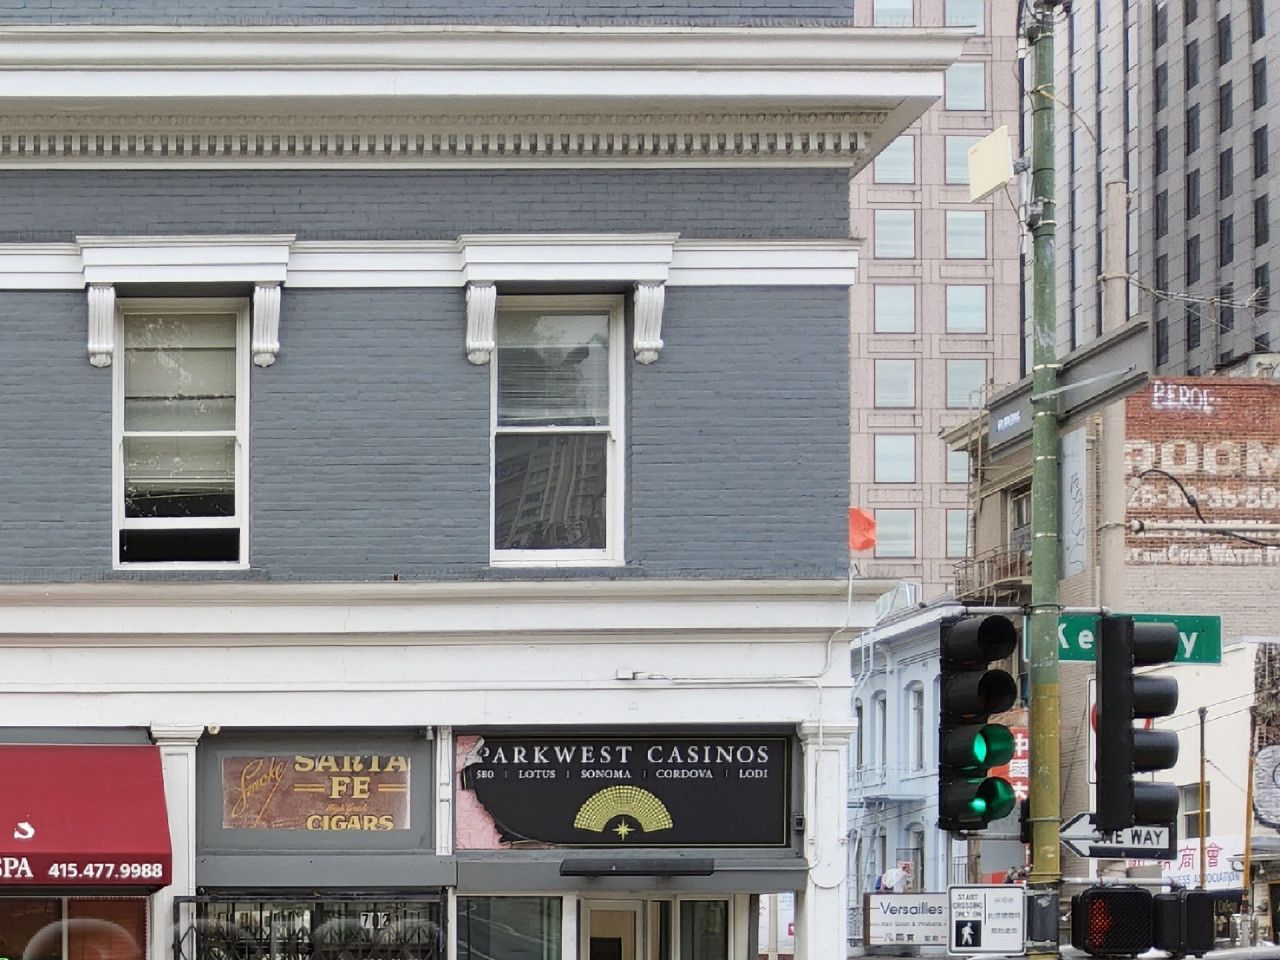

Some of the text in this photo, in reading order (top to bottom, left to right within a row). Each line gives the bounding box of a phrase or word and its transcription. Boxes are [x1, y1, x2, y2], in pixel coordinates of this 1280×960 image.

[647, 745, 769, 763] CASINOS
[519, 769, 556, 779] LOTUS
[581, 769, 632, 779] SONOMA
[656, 769, 713, 779] CORDOVA
[739, 769, 768, 779] LODI
[329, 775, 371, 799] FE
[306, 815, 394, 831] CIGARS
[1131, 828, 1163, 845] WAY
[48, 863, 163, 878] 415.477.9988
[880, 901, 943, 915] Versailles
